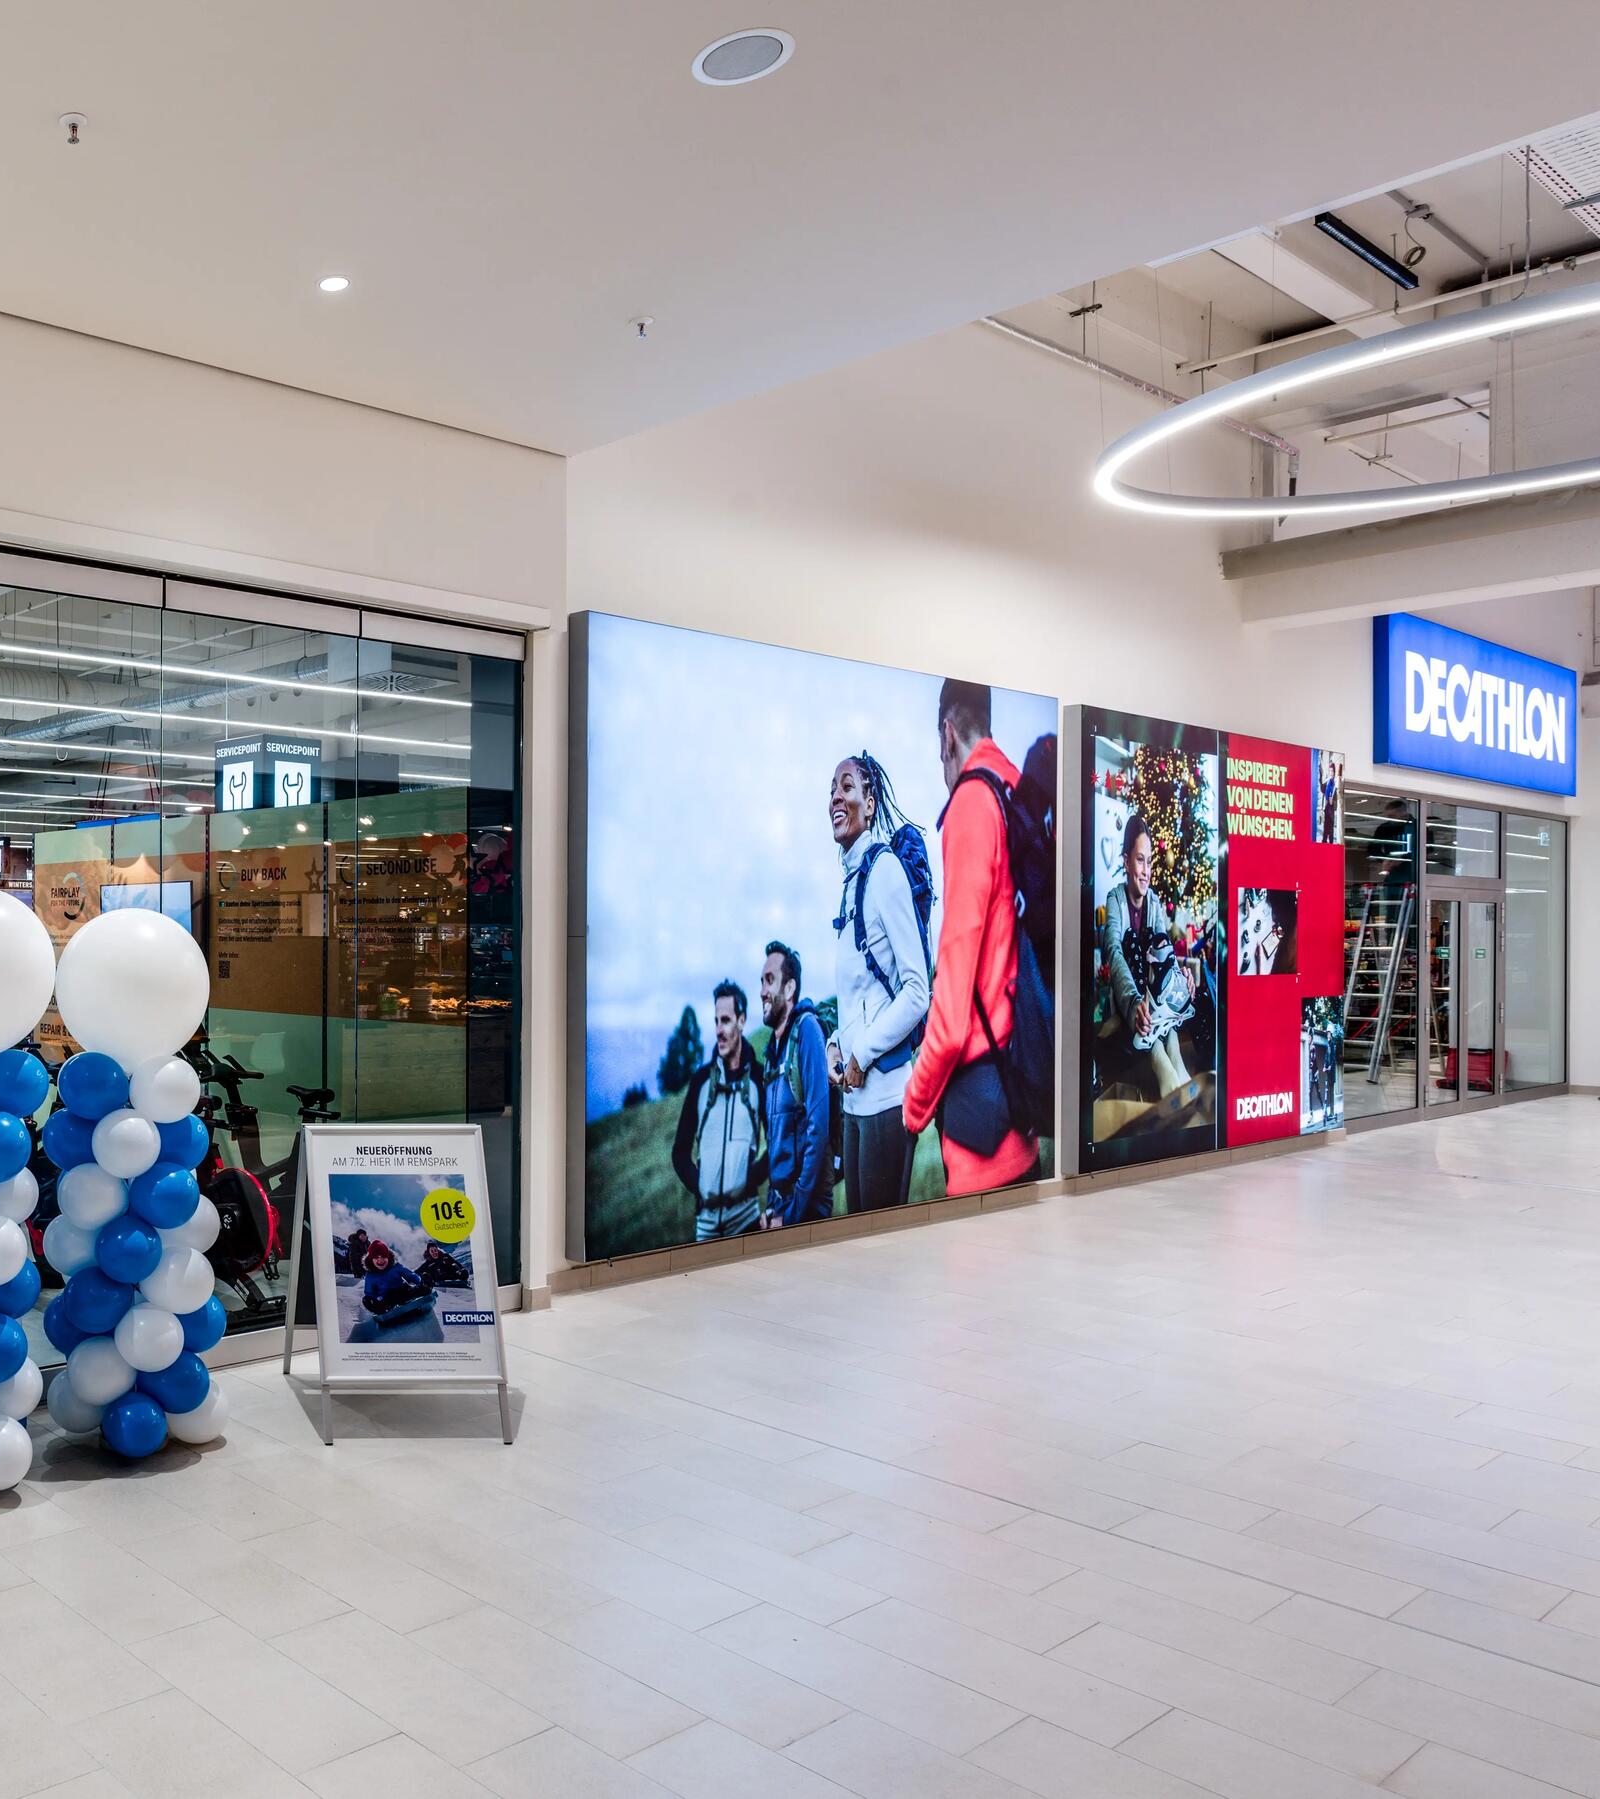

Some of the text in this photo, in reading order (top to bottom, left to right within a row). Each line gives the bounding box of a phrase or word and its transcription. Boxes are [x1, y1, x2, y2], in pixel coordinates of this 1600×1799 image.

[1405, 649, 1566, 765] DECATHLON
[216, 742, 261, 758] SERVICEPOINT
[266, 742, 320, 757] SERVICEPOINT
[1226, 757, 1288, 787] INSPIRIERT
[1226, 785, 1294, 815] VON DEINEN
[1226, 808, 1296, 841] WÜNSCHEN.
[241, 867, 287, 881] BUY BACK
[366, 858, 437, 876] SECOND USE
[50, 887, 81, 899] FAIRPLAY
[40, 1023, 61, 1035] REPAIR
[1236, 1091, 1293, 1121] DECATHLON
[356, 1145, 432, 1156] NEUERÖFFNUNG
[332, 1157, 347, 1167] AM
[369, 1157, 391, 1167] HIER
[393, 1157, 405, 1167] IM
[407, 1157, 459, 1167] REMSPARK
[431, 1200, 465, 1221] 10€
[445, 1314, 493, 1323] DECATHLON
